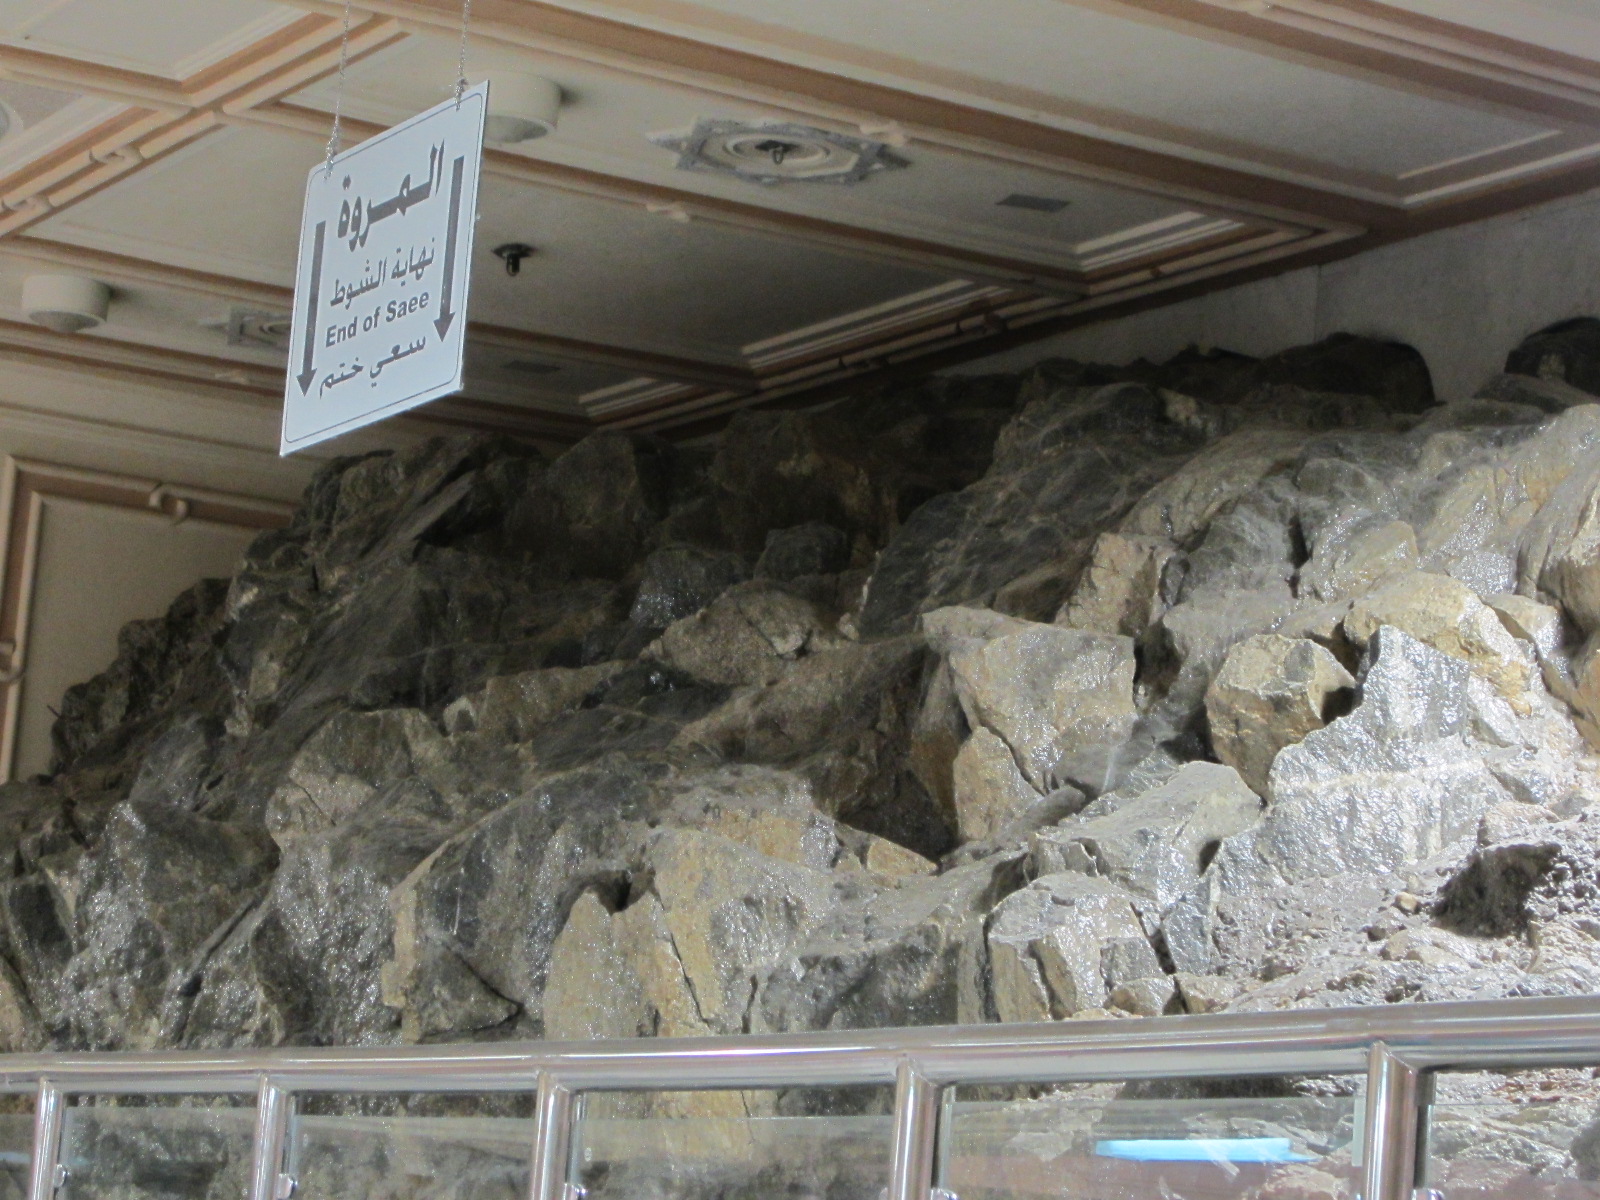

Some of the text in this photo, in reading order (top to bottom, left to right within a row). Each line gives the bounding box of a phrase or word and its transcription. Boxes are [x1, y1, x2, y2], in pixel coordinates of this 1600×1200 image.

[338, 138, 445, 251] المروة
[330, 237, 435, 310] نهاية الشوط
[325, 292, 429, 348] End of Saee
[320, 356, 364, 399] ختم
